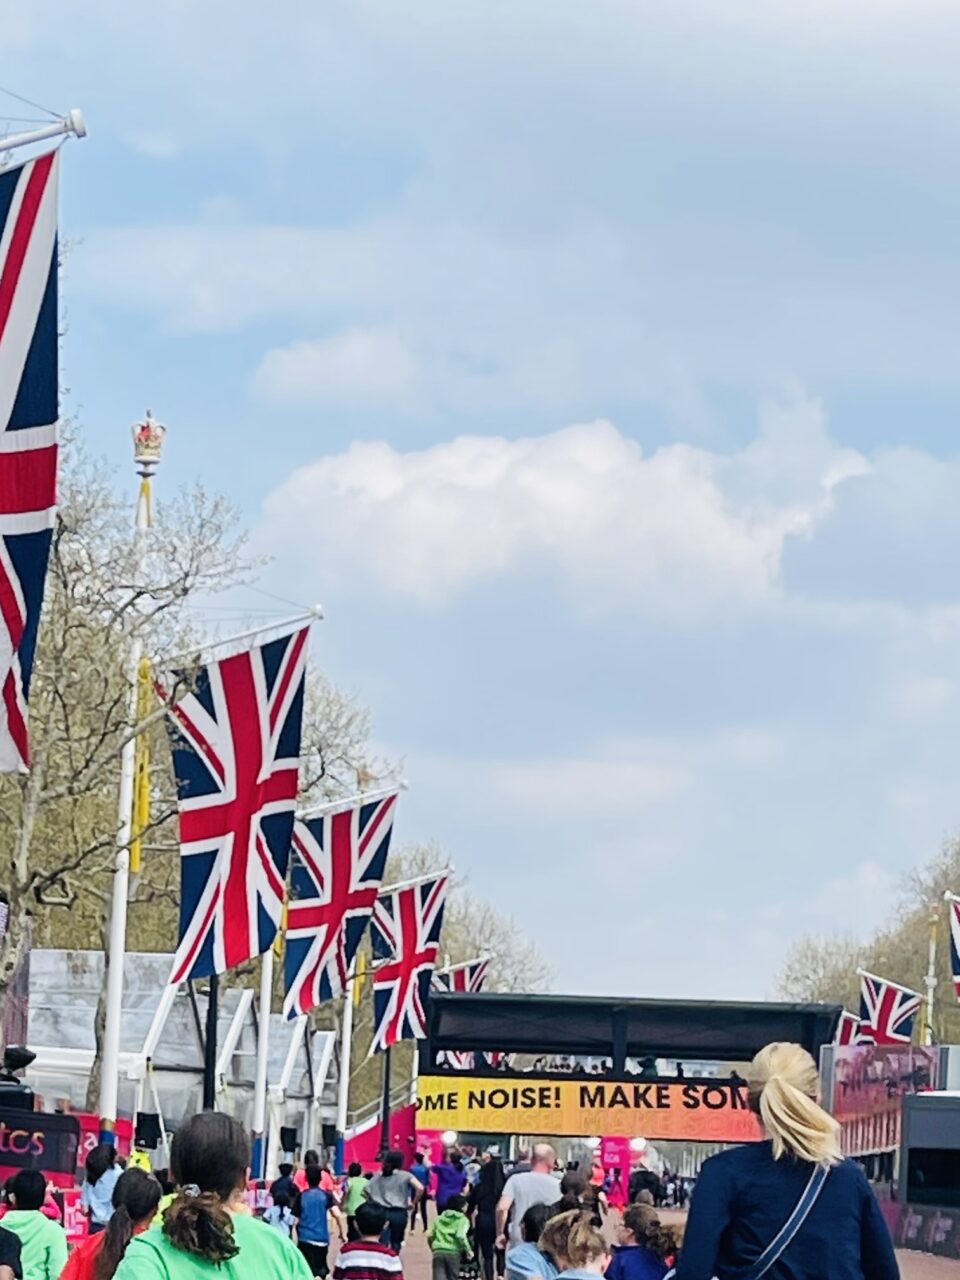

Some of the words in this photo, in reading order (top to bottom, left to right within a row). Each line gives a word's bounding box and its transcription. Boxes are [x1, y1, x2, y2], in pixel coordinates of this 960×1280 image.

[468, 1086, 561, 1109] NOISE!
[579, 1085, 671, 1109] MAKE
[682, 1085, 746, 1110] SOM
